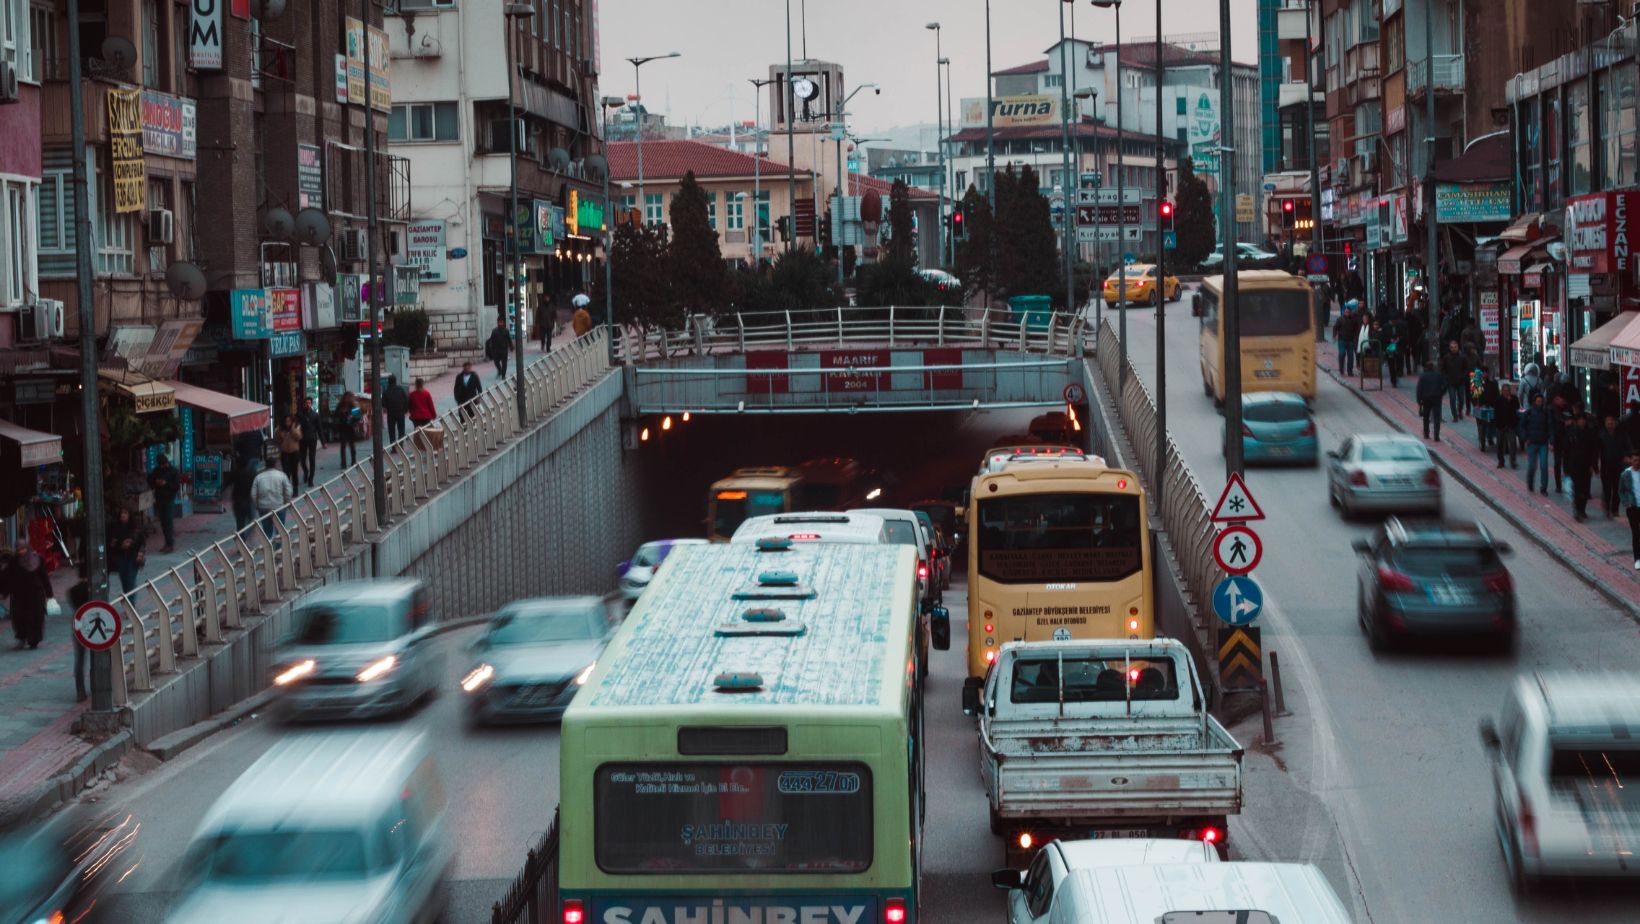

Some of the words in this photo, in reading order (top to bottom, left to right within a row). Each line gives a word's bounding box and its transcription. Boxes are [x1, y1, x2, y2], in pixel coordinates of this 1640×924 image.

[991, 100, 1051, 116] Turna
[1091, 193, 1128, 202] Karagz
[1110, 215, 1139, 223] (Cstle)
[1615, 194, 1628, 270] ECZANE
[844, 381, 867, 389] 2004
[1012, 606, 1043, 616] GAZİANTEP
[1043, 605, 1079, 616] BÜYÜKŞEHİR
[1079, 604, 1111, 615] BELEDİYESİ
[1049, 617, 1062, 625] HALK
[1063, 616, 1087, 625] OTOBÜSÜ
[681, 819, 788, 846] ŞAHİNBEY
[695, 841, 776, 856] BELEDİYESİ
